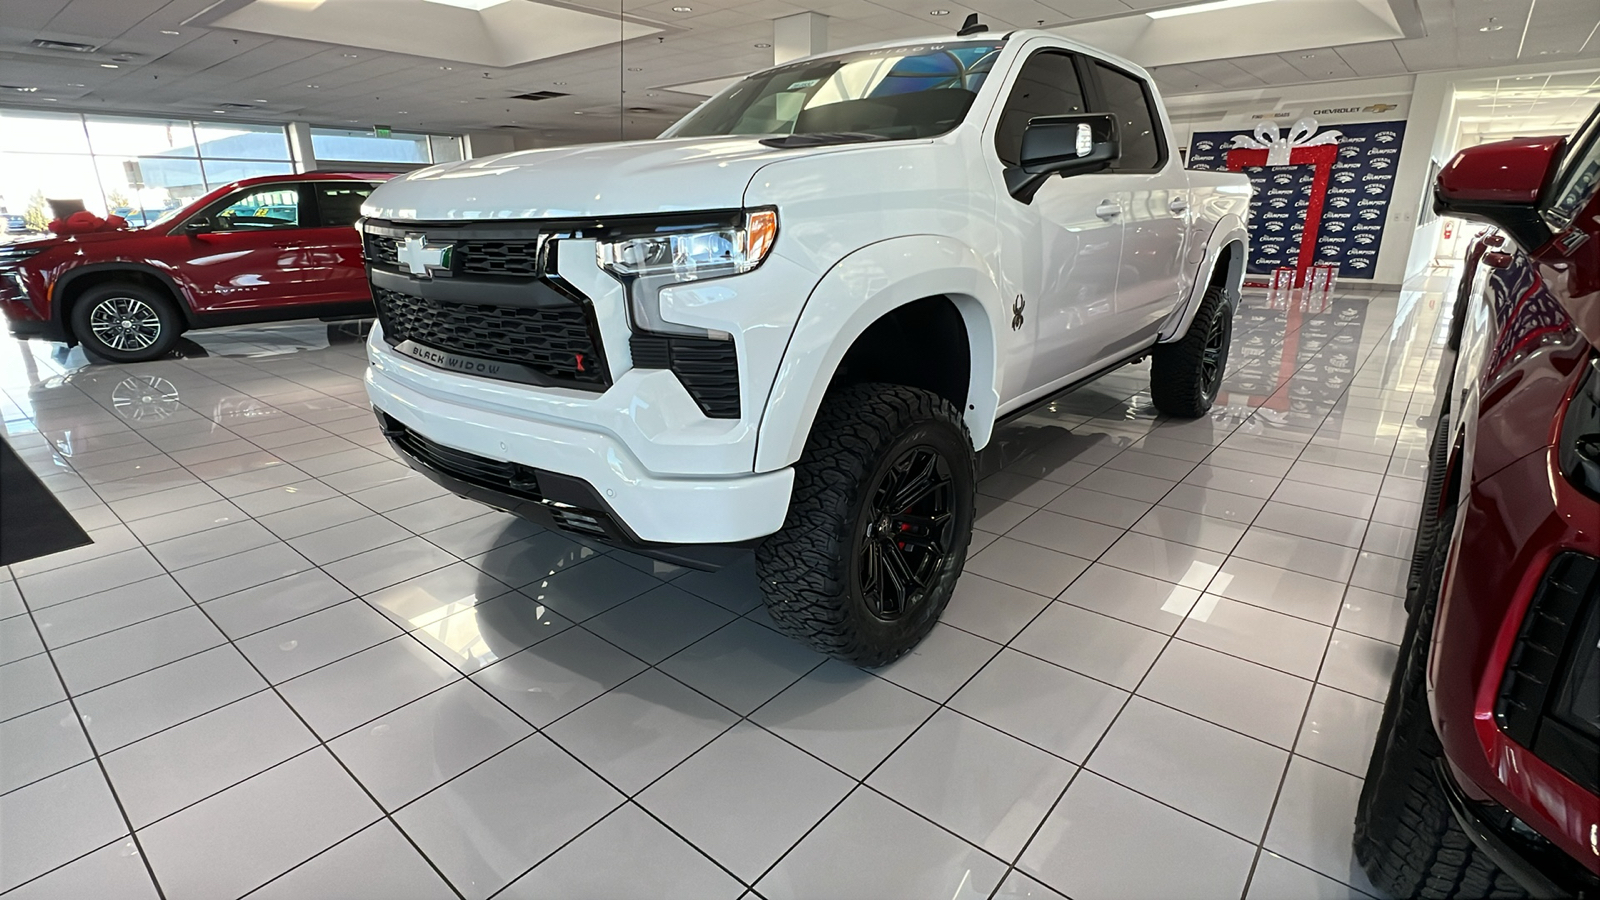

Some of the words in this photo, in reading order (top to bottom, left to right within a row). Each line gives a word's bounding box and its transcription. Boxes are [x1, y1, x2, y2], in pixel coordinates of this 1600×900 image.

[868, 45, 945, 56] WIDOW
[1313, 106, 1361, 115] CHEVROLET
[412, 346, 444, 364] BLACK
[448, 358, 500, 374] WIDOW
